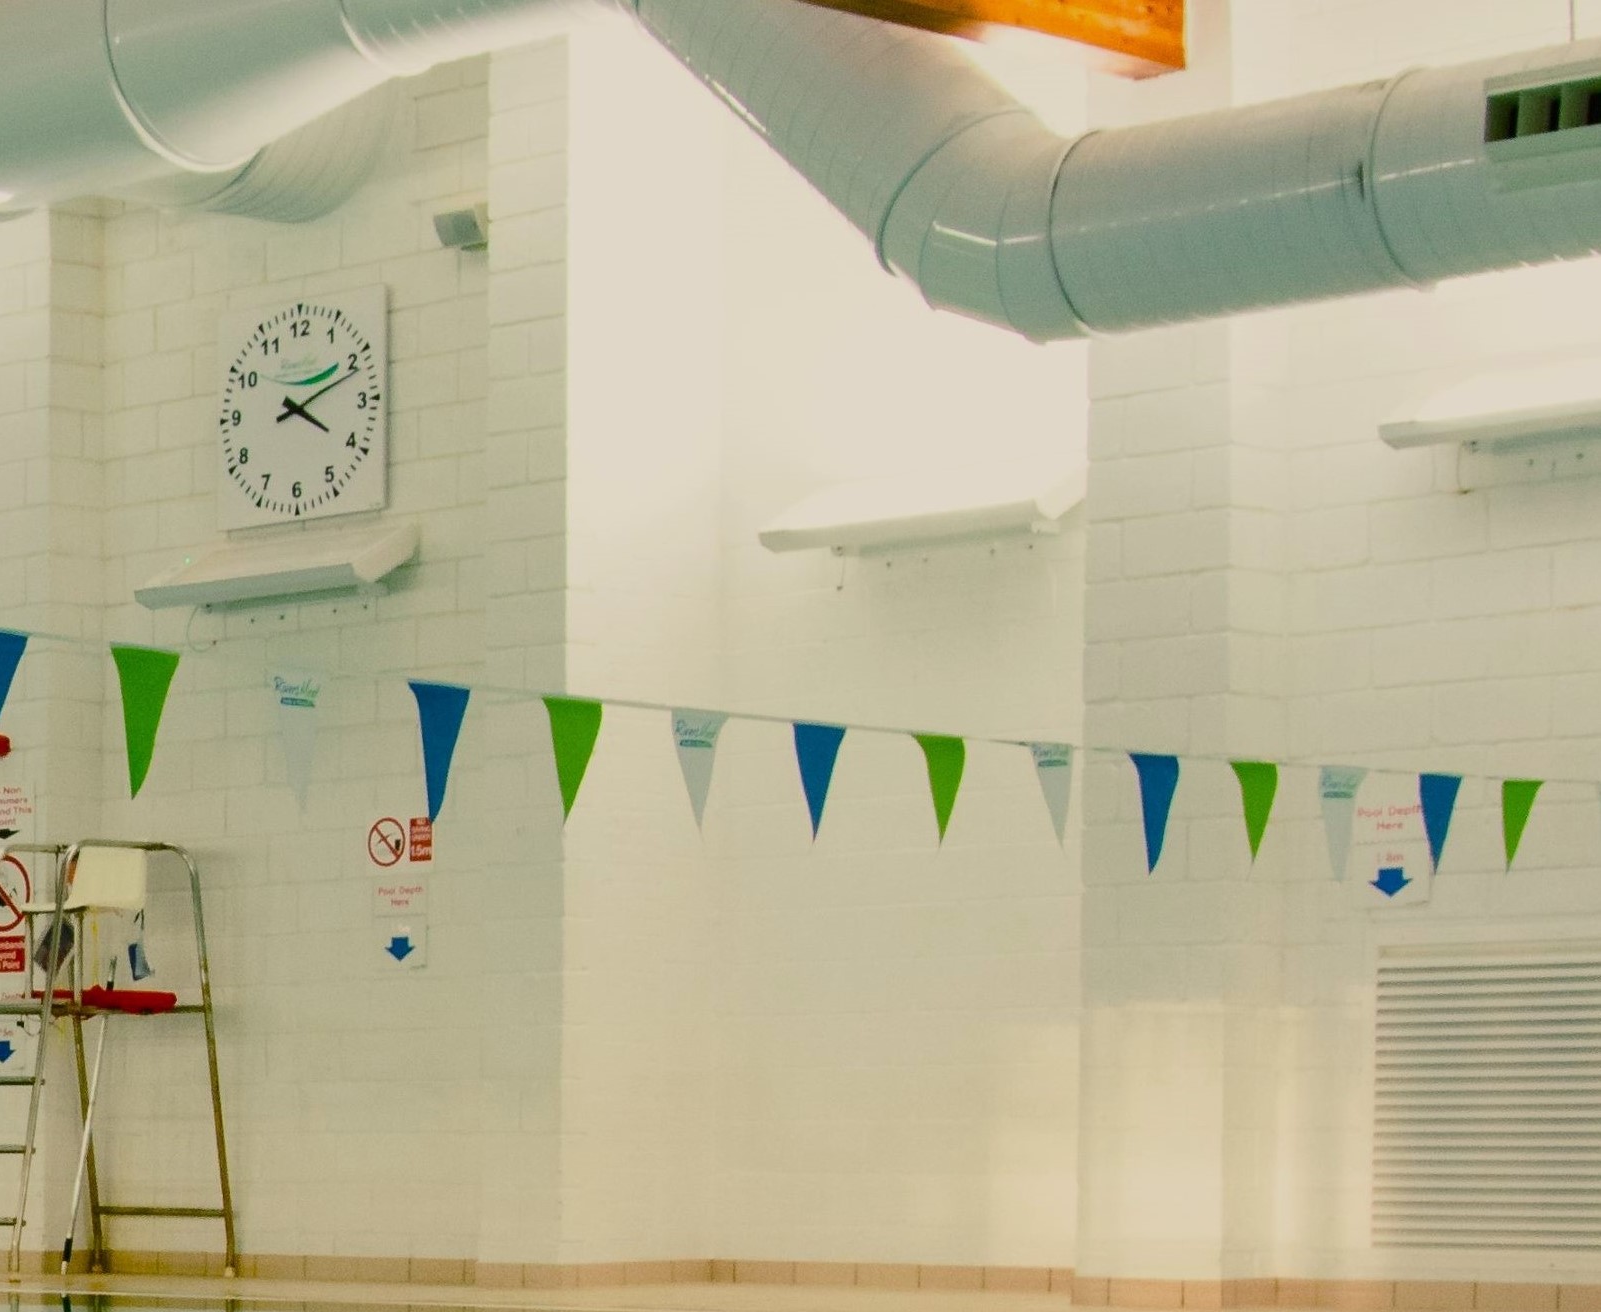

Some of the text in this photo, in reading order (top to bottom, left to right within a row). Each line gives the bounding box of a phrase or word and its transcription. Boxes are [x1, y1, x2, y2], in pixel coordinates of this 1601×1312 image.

[289, 319, 311, 339] 12
[326, 327, 335, 345] 1
[260, 337, 280, 356] 11
[347, 353, 359, 371] 2
[238, 370, 258, 390] 10
[356, 391, 368, 410] 3
[231, 410, 242, 427] 9
[345, 431, 357, 449] 4
[238, 447, 249, 465] 8
[261, 473, 272, 491] 7
[324, 465, 335, 483] 5
[291, 480, 302, 498] 6
